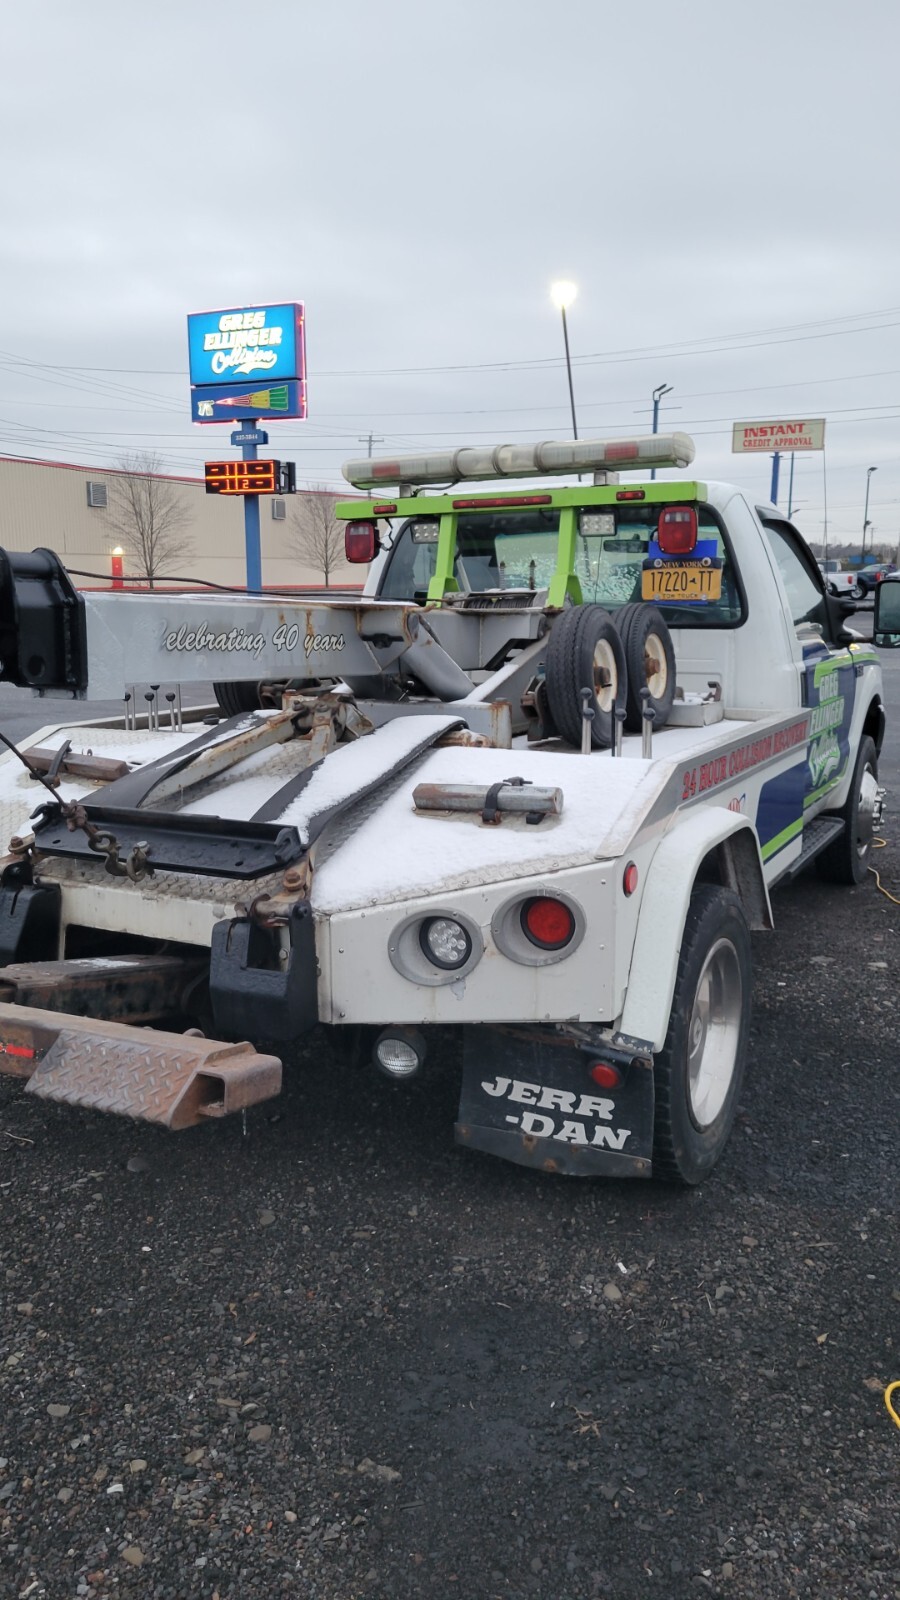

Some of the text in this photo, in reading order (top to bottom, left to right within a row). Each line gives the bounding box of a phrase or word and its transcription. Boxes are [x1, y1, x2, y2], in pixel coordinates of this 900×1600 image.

[219, 311, 265, 332] GREG
[203, 327, 283, 351] ELLINGER
[211, 346, 277, 375] Collision
[743, 437, 813, 447] CREDIT APPROVAL
[744, 423, 806, 438] INSTANT
[651, 571, 688, 592] 17220
[272, 623, 299, 651] 40
[304, 633, 346, 658] years
[681, 768, 697, 800] 24
[699, 755, 727, 792] HOUR
[729, 736, 772, 776] COLLISION
[481, 1076, 616, 1120] JERR
